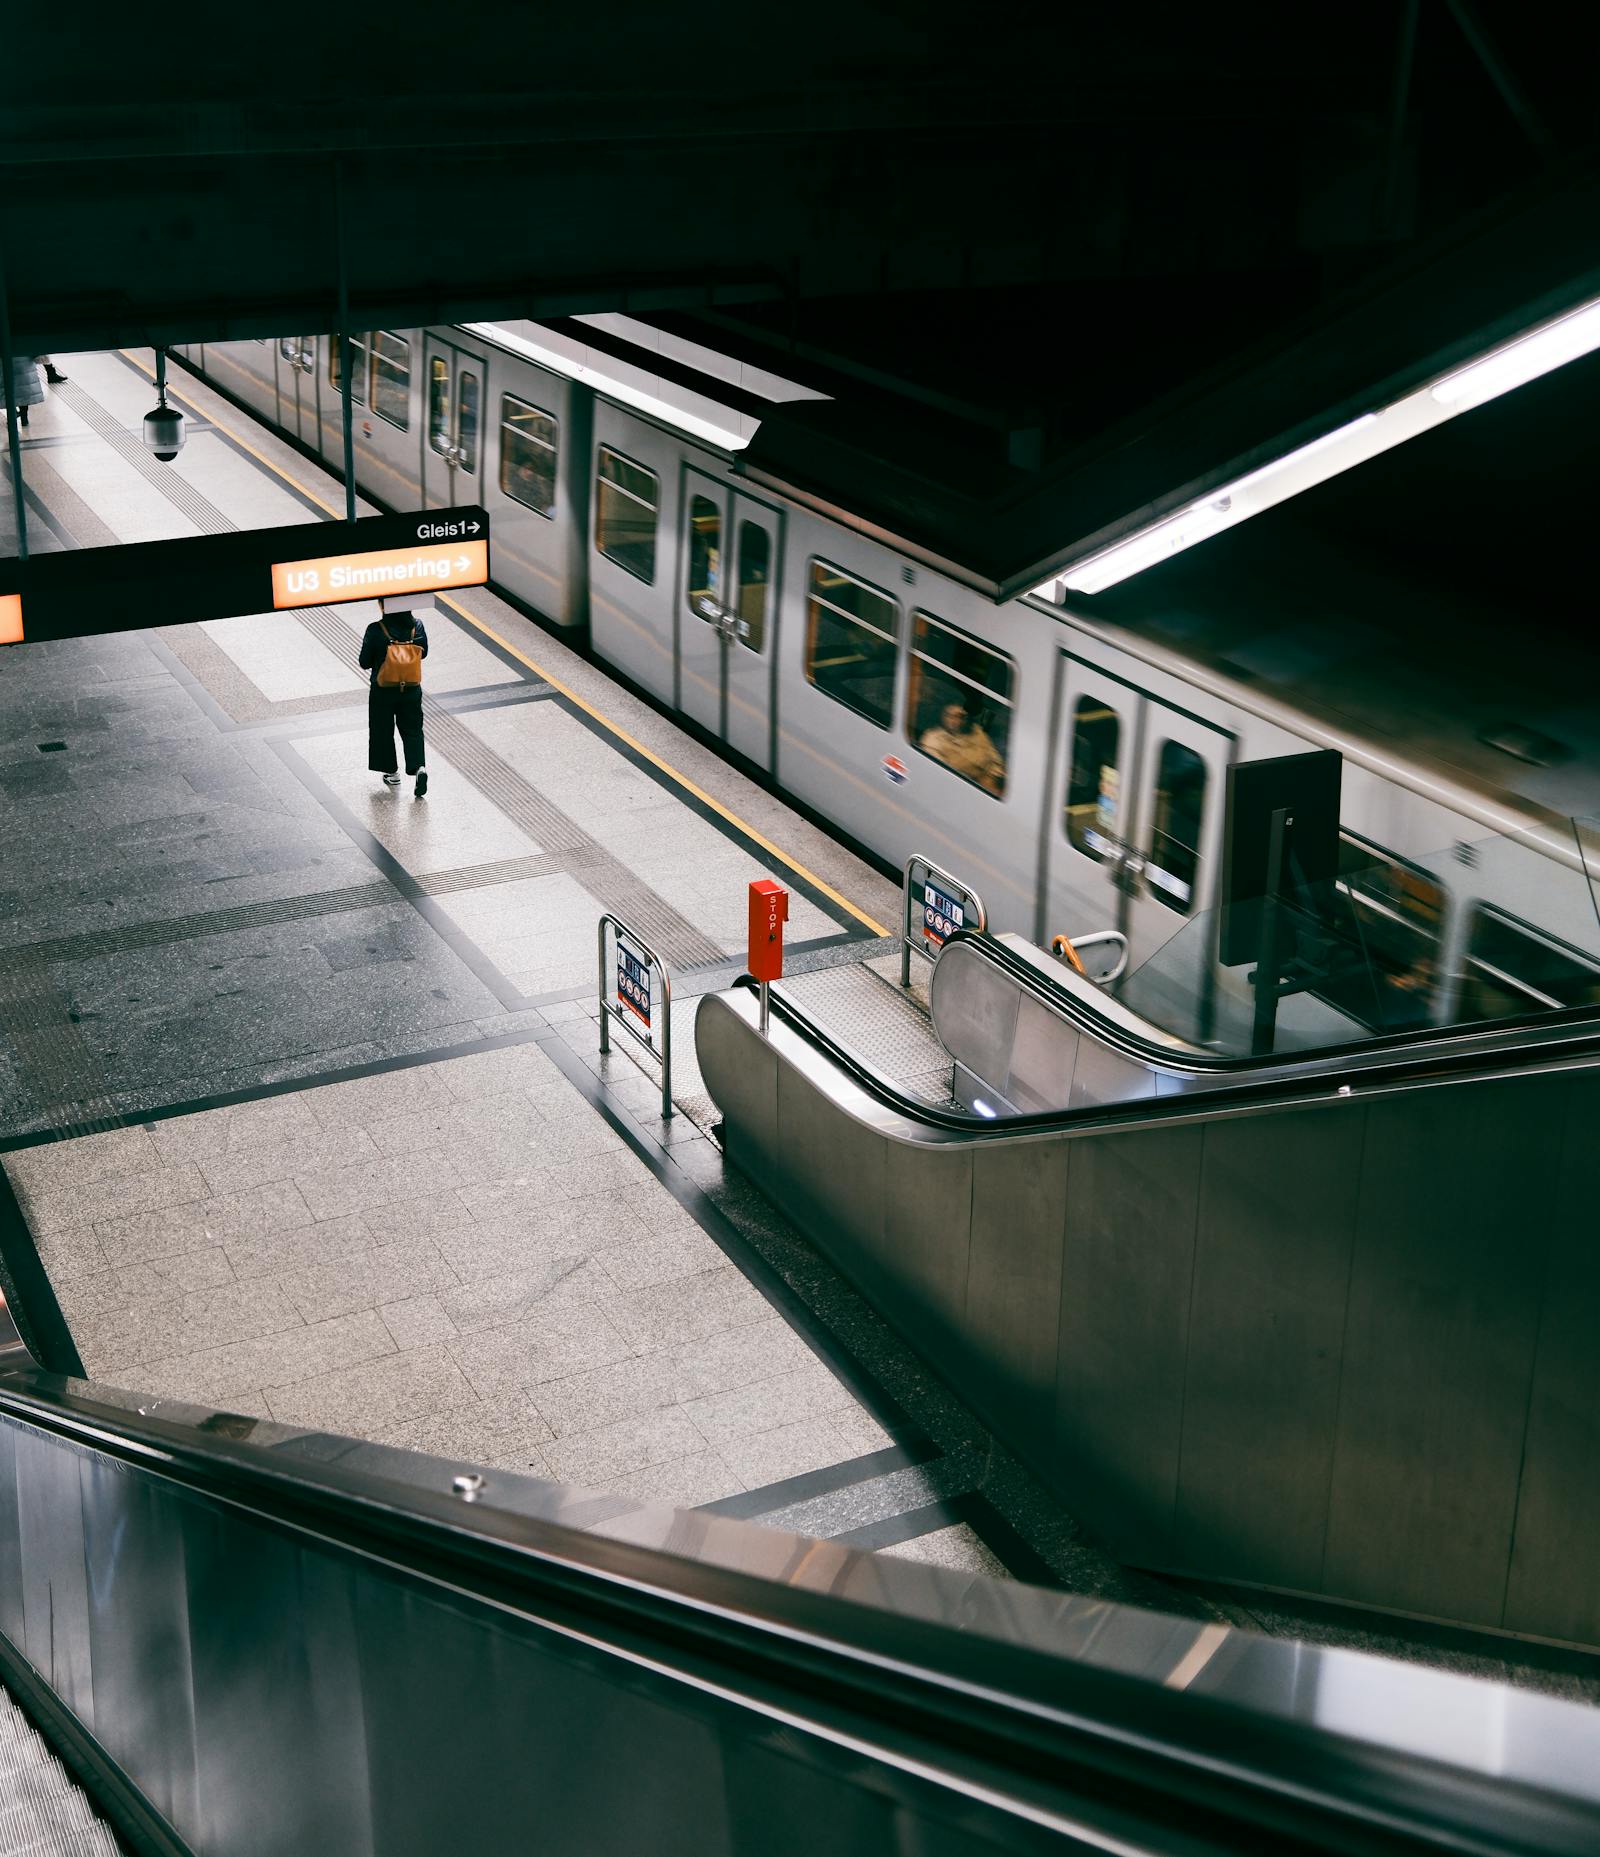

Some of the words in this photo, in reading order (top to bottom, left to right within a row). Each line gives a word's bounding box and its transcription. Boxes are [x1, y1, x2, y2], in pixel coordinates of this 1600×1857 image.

[287, 570, 320, 593] U3
[329, 557, 451, 588] Simmering
[769, 895, 777, 930] STOP
